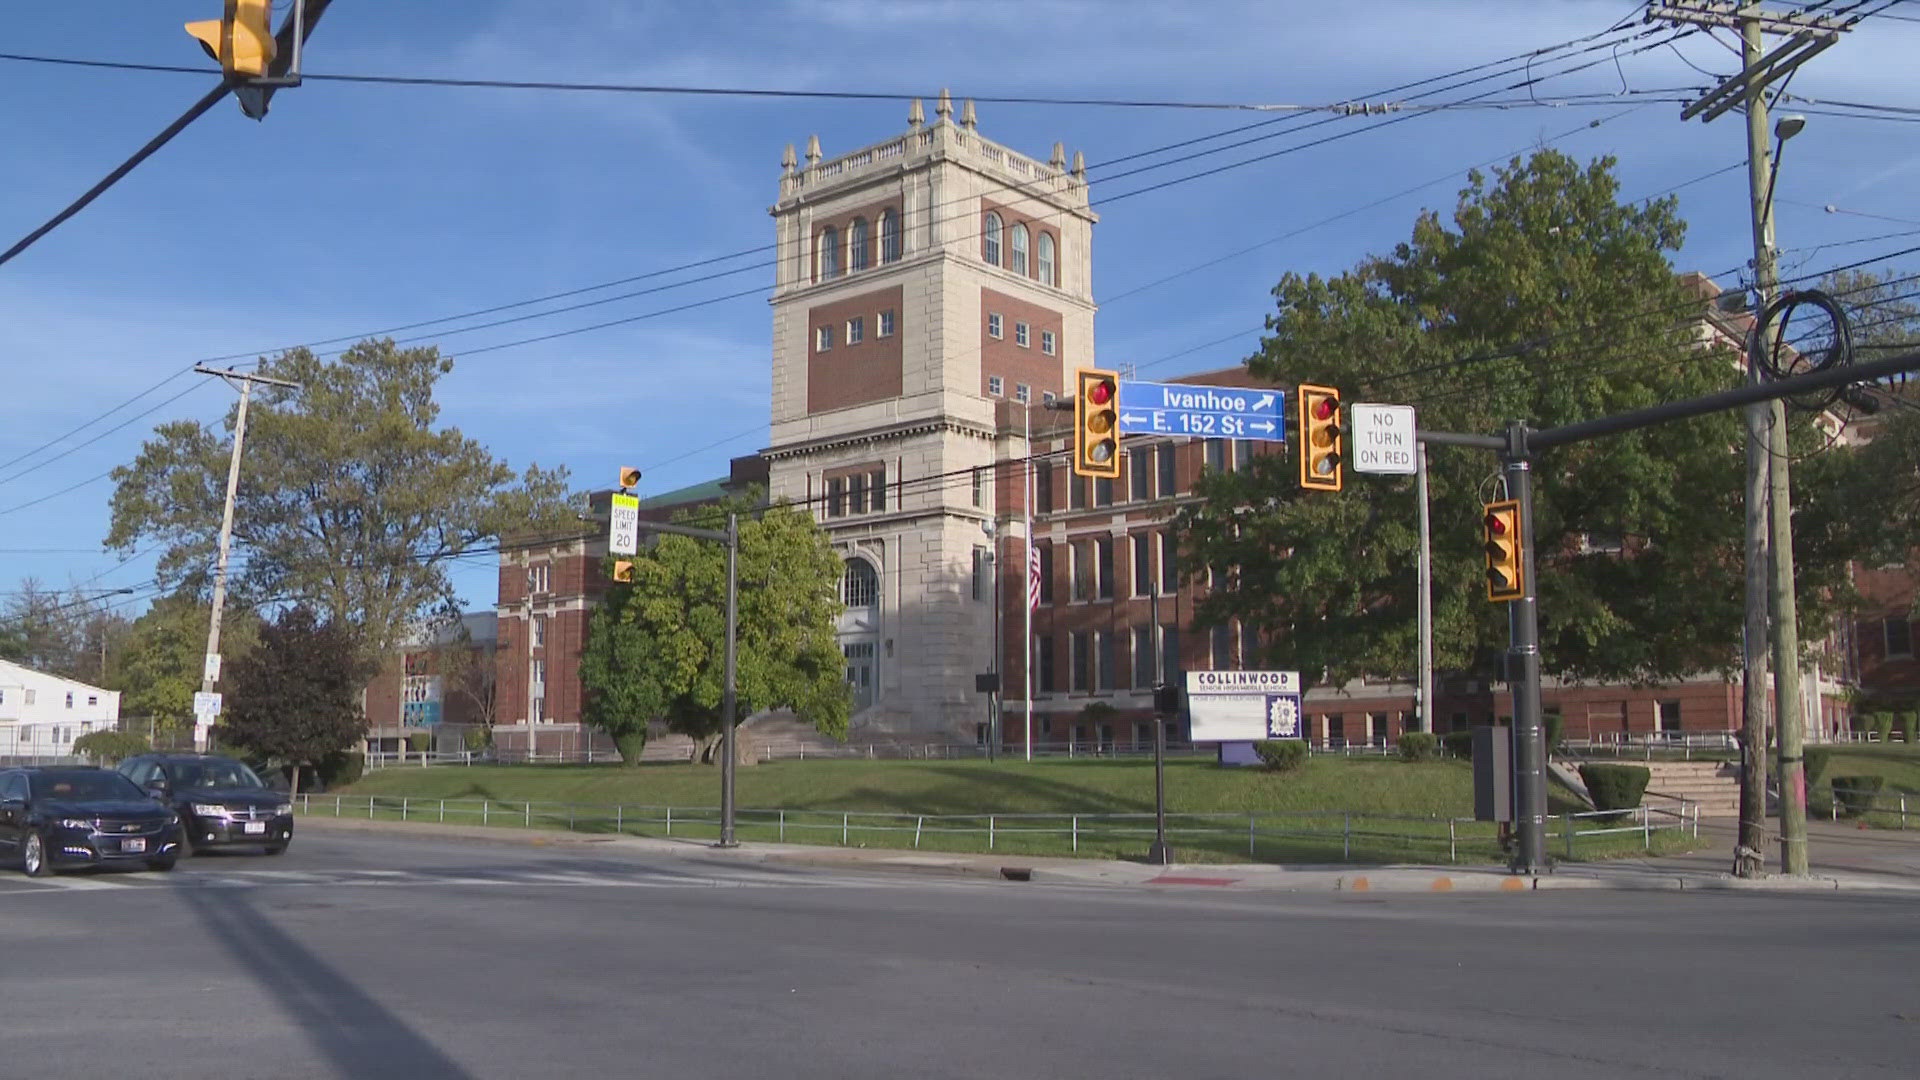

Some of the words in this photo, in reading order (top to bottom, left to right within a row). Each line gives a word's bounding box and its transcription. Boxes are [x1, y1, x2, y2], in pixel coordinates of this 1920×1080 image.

[1163, 388, 1246, 412] Ivanhoe
[1153, 411, 1171, 431] E.
[1180, 413, 1215, 433] 152
[1221, 415, 1245, 435] St
[1373, 413, 1394, 426] NO
[1367, 431, 1402, 446] TURN
[1361, 449, 1378, 464] ON
[1385, 451, 1409, 465] RED
[614, 508, 635, 520] SPEED
[616, 520, 632, 532] LIMIT
[616, 534, 631, 547] 20
[1198, 673, 1289, 684] COLLINWOOD
